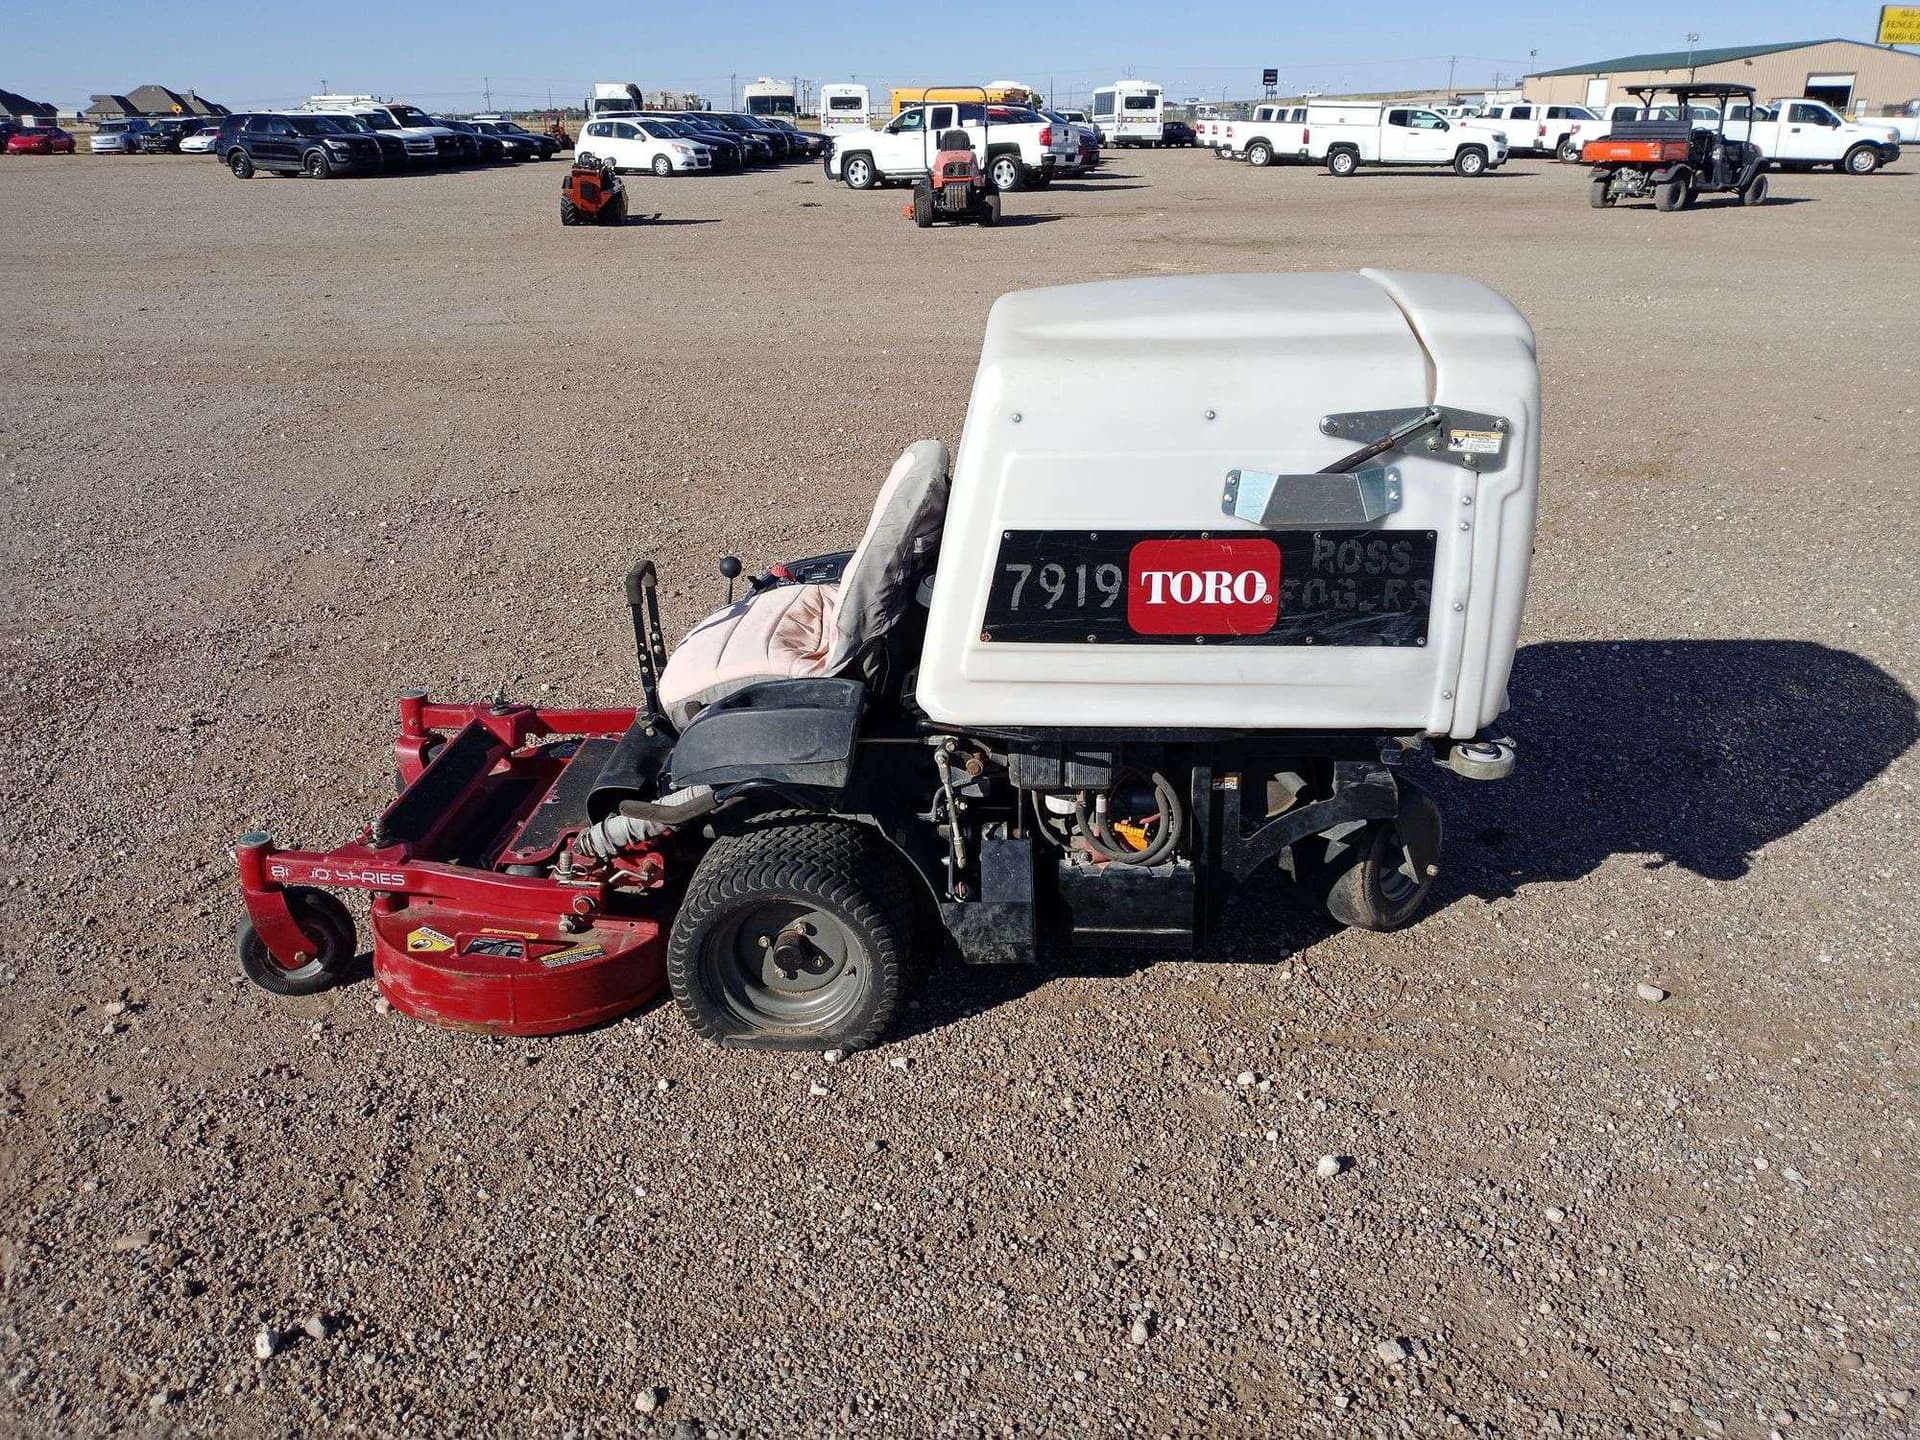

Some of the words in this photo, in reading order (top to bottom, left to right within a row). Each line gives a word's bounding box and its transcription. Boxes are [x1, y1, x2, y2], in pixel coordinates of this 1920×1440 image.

[1312, 539, 1413, 575] ROSS
[1006, 563, 1122, 611] 7919
[1141, 570, 1267, 604] TORO
